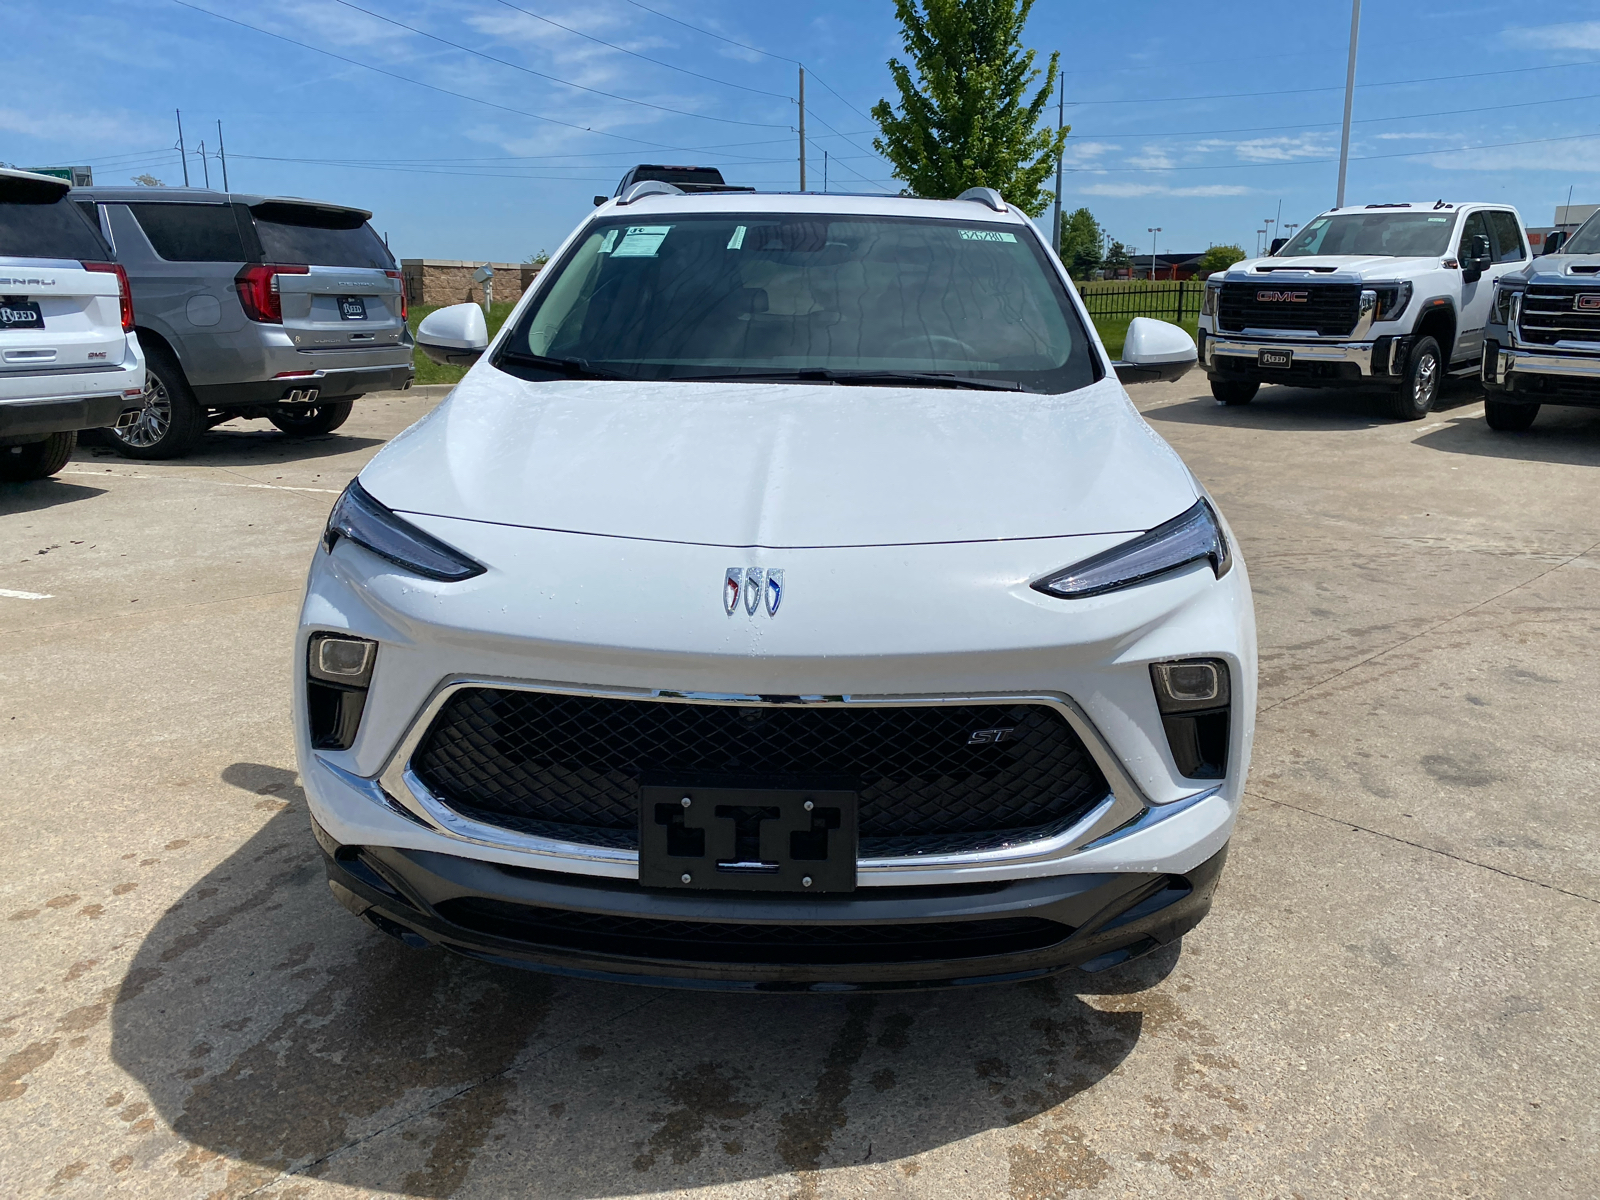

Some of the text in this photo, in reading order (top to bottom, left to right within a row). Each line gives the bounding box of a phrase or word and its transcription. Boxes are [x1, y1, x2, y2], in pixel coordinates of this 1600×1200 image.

[1257, 291, 1308, 302] GMC
[0, 307, 37, 323] REED
[343, 303, 362, 315] REED
[1263, 354, 1287, 363] REED
[968, 728, 1014, 745] ST
